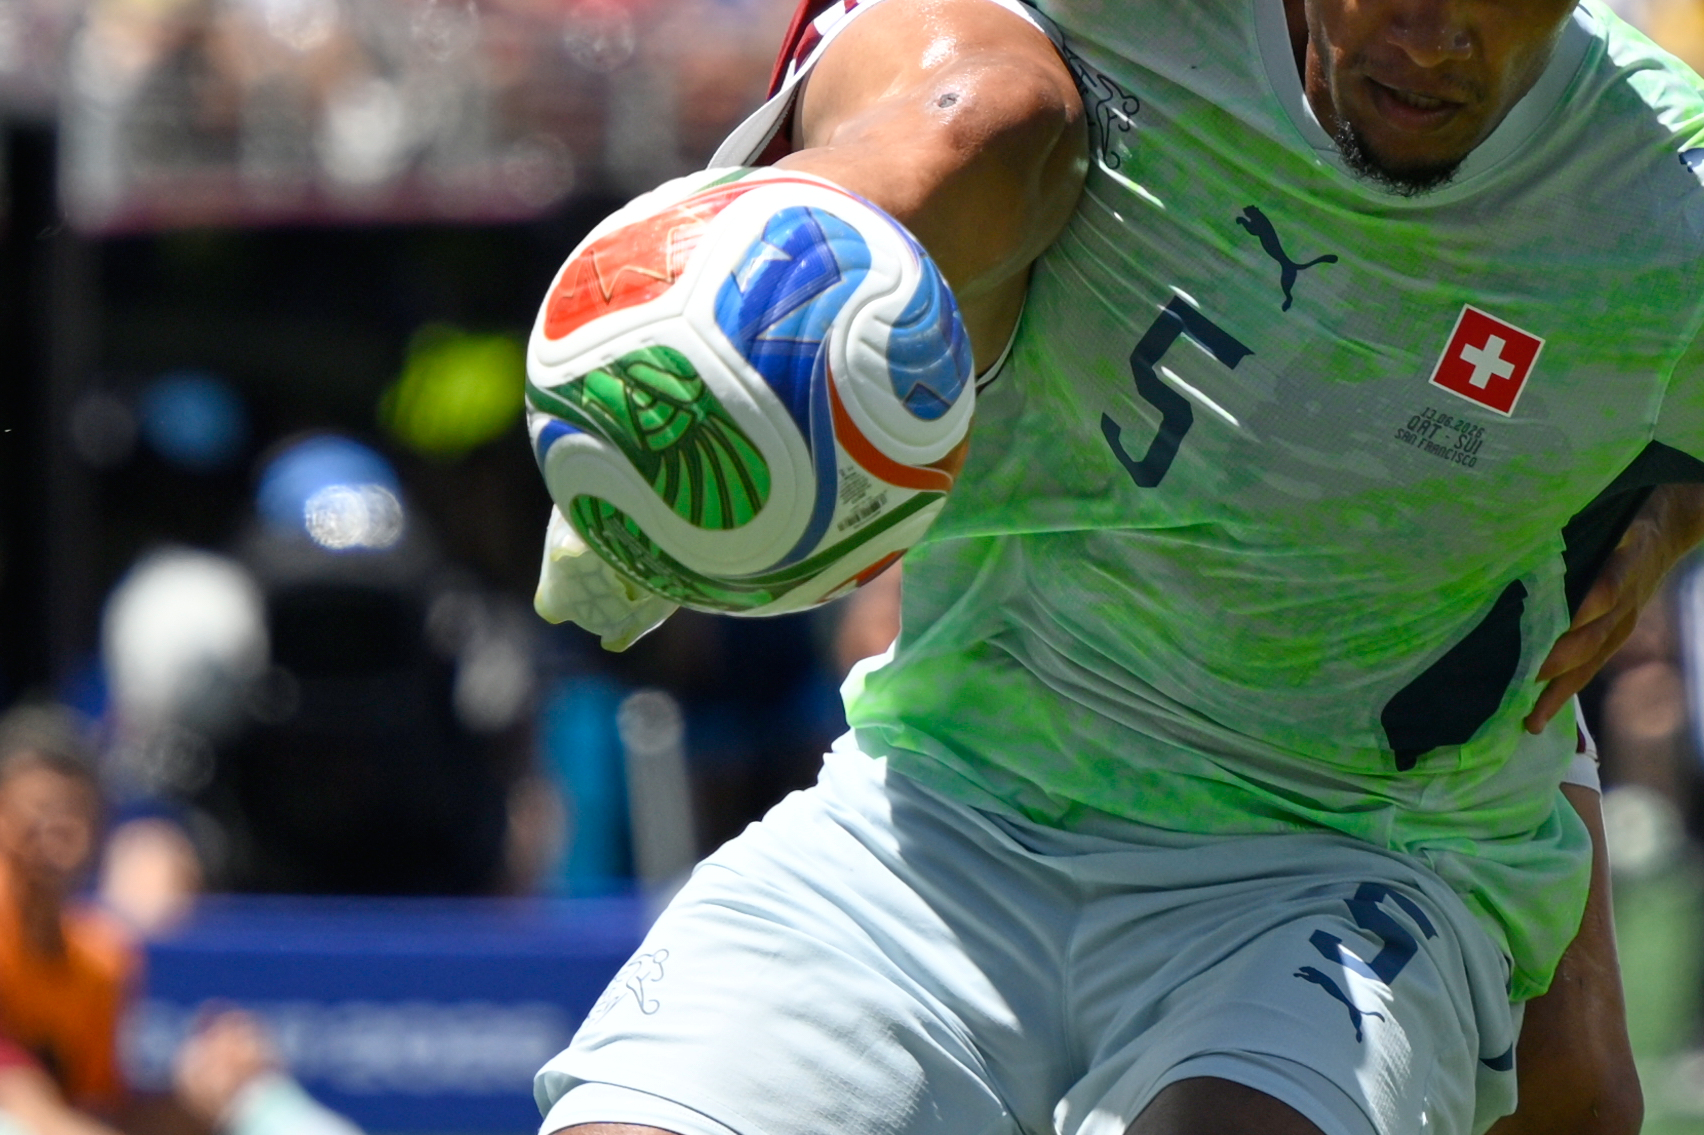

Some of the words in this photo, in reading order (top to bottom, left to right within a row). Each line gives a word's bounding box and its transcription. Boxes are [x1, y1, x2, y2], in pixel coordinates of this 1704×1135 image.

[1101, 295, 1255, 488] 5
[1407, 415, 1442, 440] QAT
[1453, 434, 1483, 455] SUI
[1420, 407, 1485, 439] 13.06.2026
[1394, 427, 1418, 445] SAN
[1417, 437, 1478, 468] FRANCISCO
